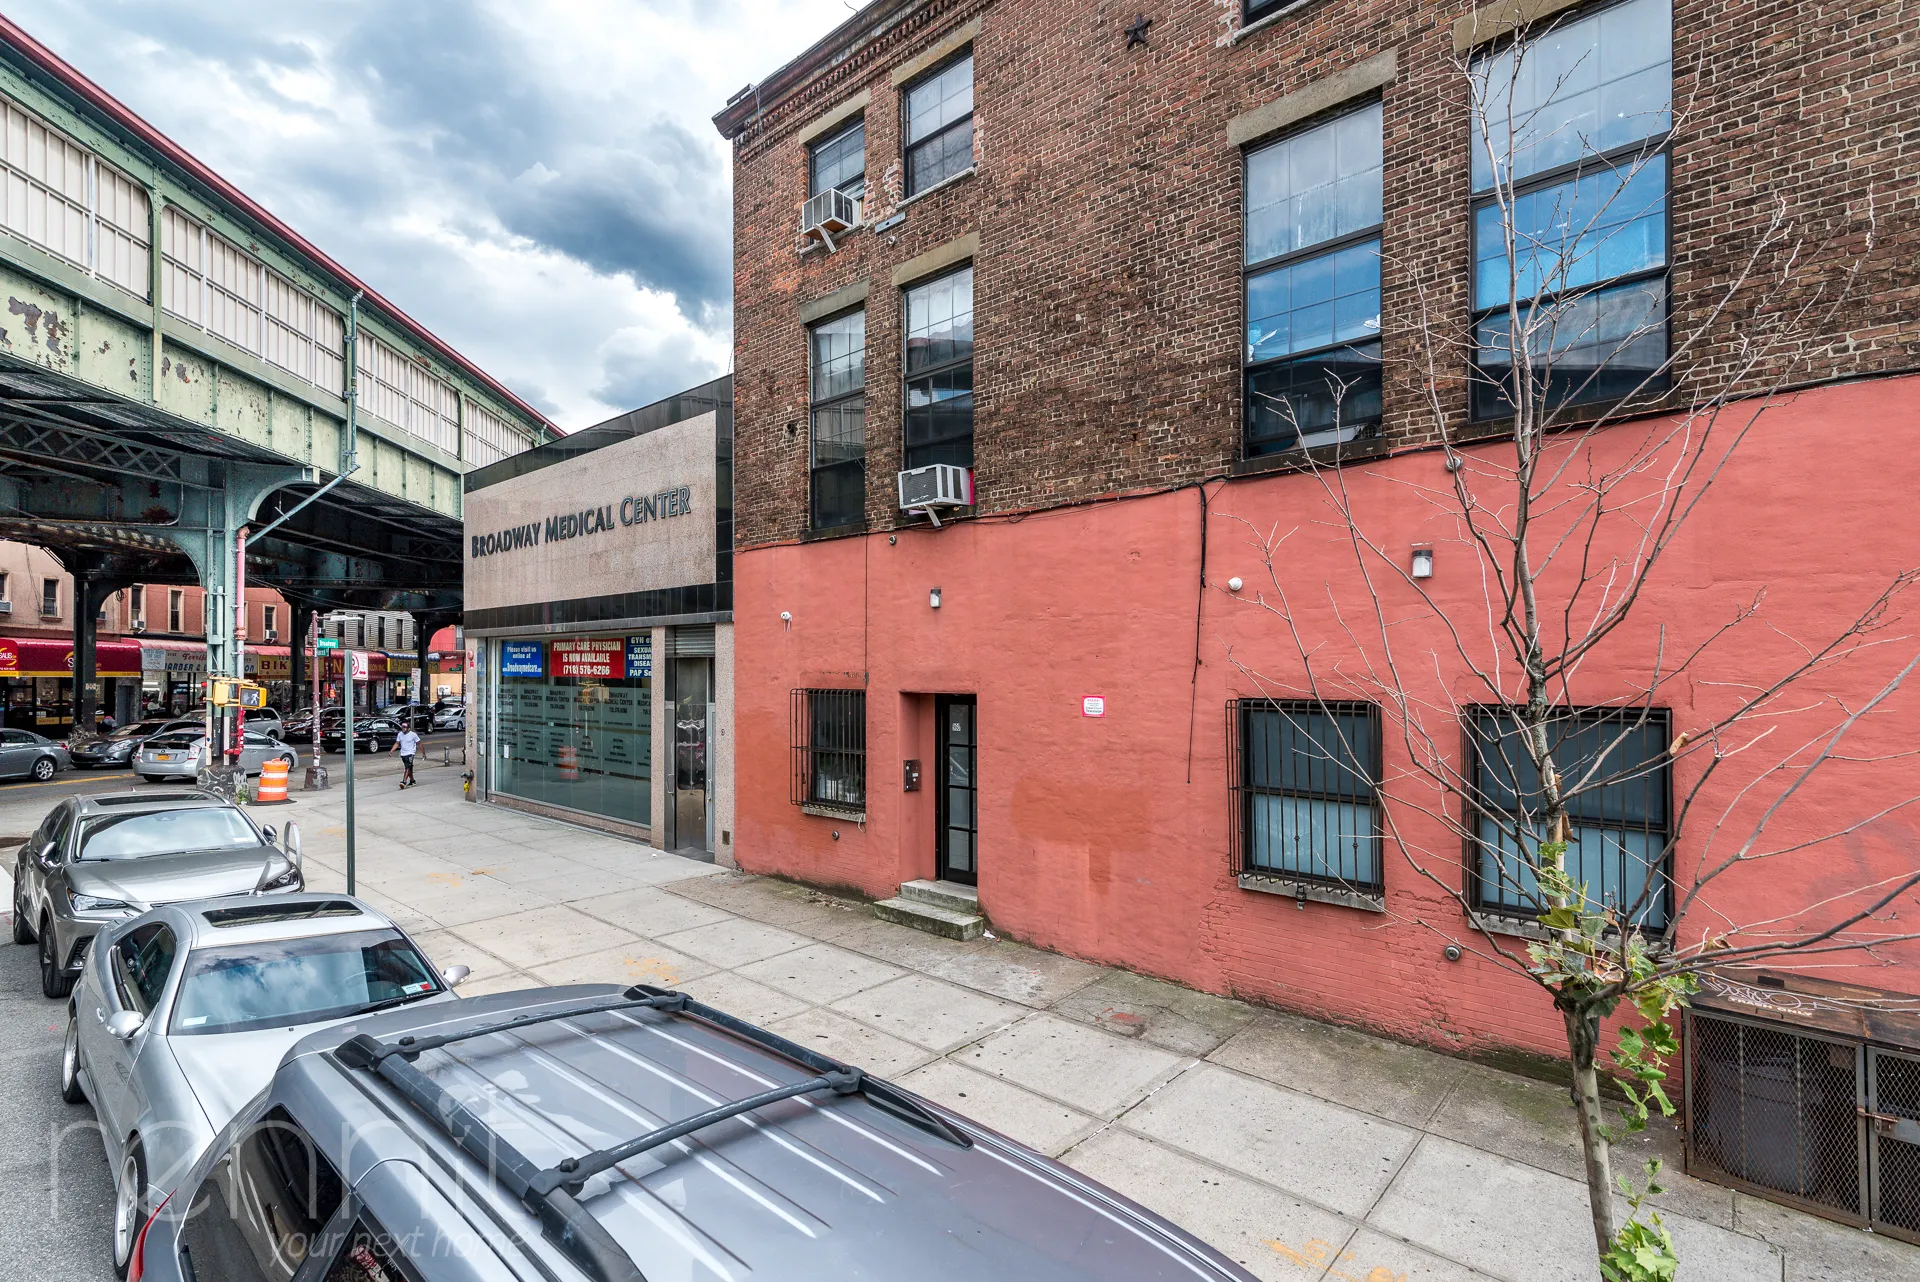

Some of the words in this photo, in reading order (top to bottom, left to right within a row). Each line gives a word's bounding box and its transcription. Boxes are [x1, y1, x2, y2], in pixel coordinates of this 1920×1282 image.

[472, 522, 541, 558] BROADWAY
[545, 505, 614, 543] MEDICAL
[619, 486, 691, 527] CENTER
[554, 642, 576, 651] PRIMARY
[576, 641, 590, 651] CARE
[592, 641, 621, 651] PHYSICIAN
[563, 653, 568, 662] IS
[569, 653, 581, 662] NOW
[581, 653, 610, 663] AVAILABLE
[165, 662, 193, 671] ARBER
[261, 660, 307, 673] BIKS
[563, 664, 579, 675] (718)
[579, 665, 610, 675] 576-6266
